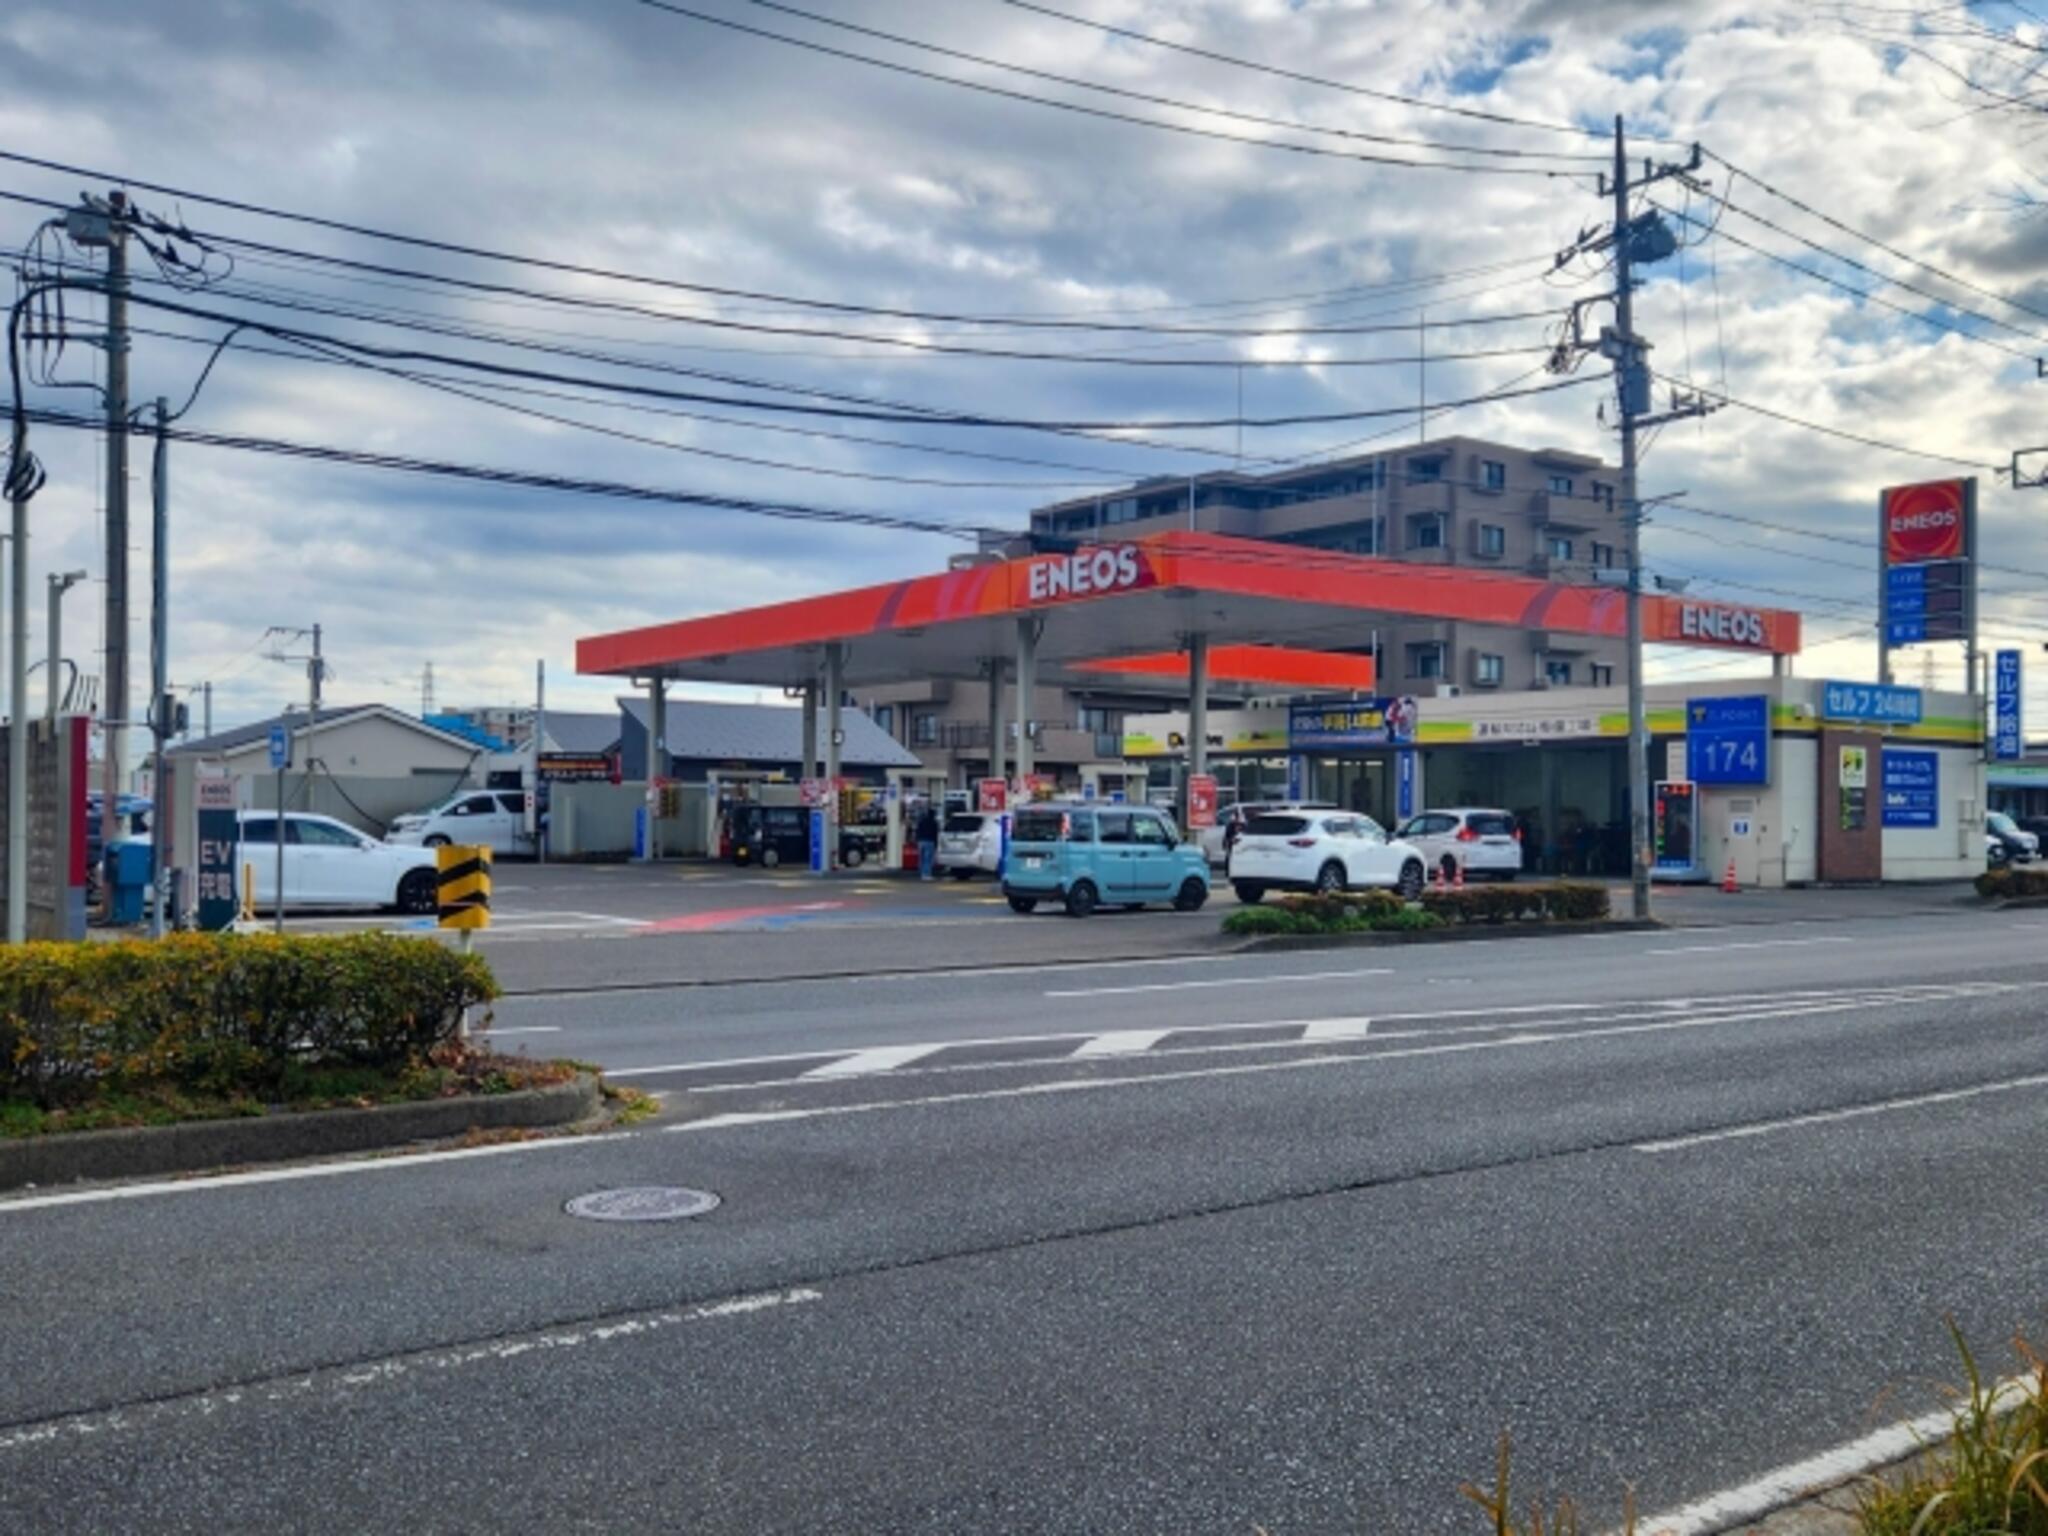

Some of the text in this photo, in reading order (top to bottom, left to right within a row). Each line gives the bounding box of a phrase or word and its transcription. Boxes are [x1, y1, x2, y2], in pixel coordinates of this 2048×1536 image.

[1890, 510, 1956, 533] ENEOS
[1030, 546, 1139, 598] ENEOS
[1683, 604, 1761, 643] ENEOS
[1828, 686, 1869, 714] セルフ
[2000, 655, 2017, 753] セルフ給油
[1705, 741, 1758, 772] 174
[200, 841, 231, 865] EV
